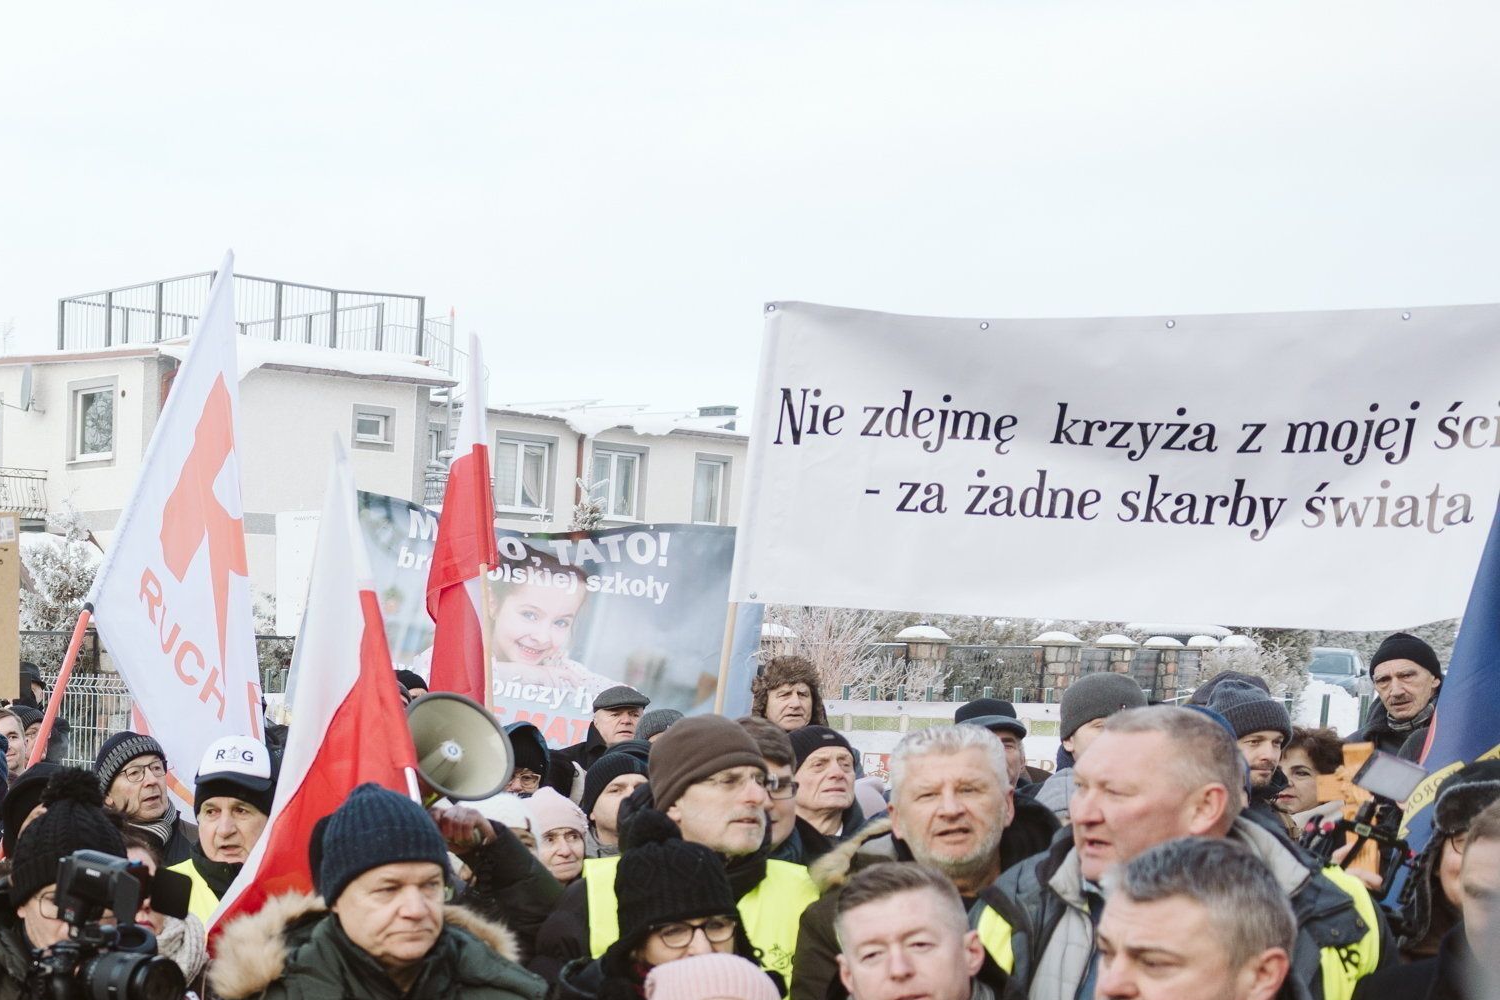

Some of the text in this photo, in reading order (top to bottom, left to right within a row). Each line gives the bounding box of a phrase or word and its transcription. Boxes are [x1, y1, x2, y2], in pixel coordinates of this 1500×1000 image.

[773, 388, 845, 446] Nie
[860, 389, 1018, 455] zdejmę
[1050, 402, 1218, 461] krzyża
[1236, 422, 1267, 453] z
[1281, 400, 1420, 465] mojej
[896, 481, 948, 514] za
[964, 469, 1101, 521] żadne
[1117, 474, 1287, 542] skarby
[1301, 479, 1474, 534] świata
[548, 531, 671, 568] TATO!
[487, 563, 578, 595] olskiej
[585, 571, 670, 605] szkoły
[139, 566, 227, 723] RUCH
[492, 675, 569, 710] ończy
